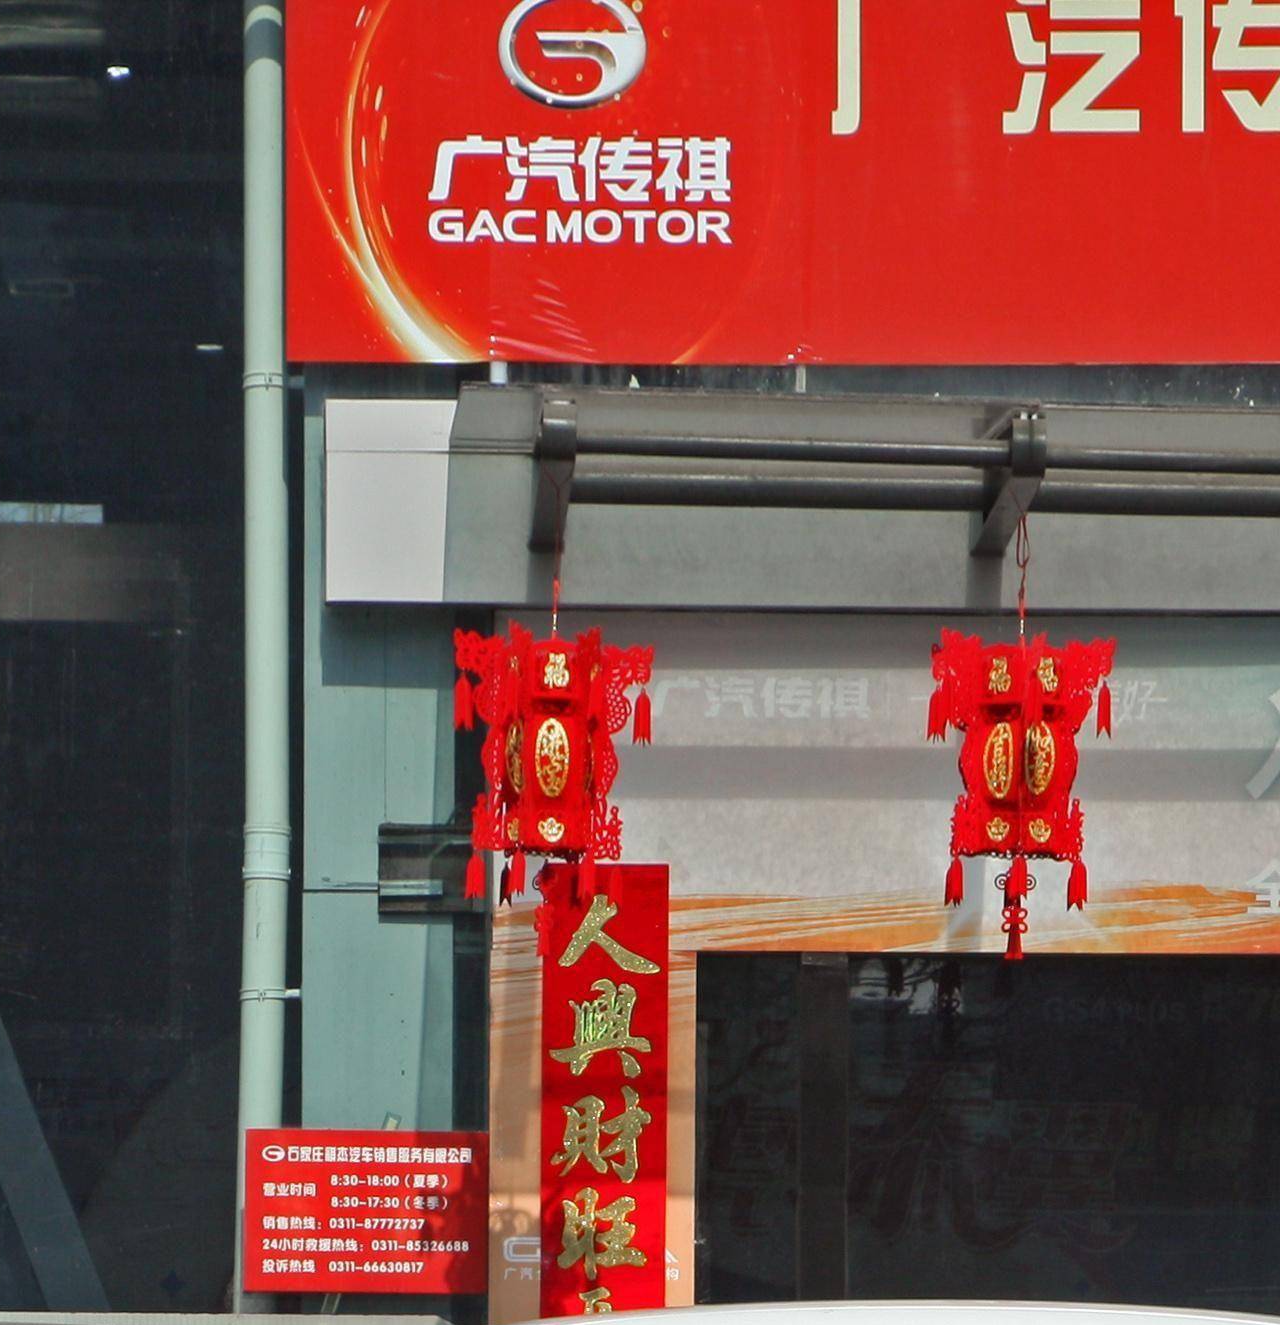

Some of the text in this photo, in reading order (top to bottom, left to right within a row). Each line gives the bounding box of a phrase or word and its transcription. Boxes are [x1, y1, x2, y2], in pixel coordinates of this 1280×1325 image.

[428, 136, 732, 203] 广汽传祺
[428, 209, 733, 244] GAC MOTOR
[262, 1182, 317, 1197] 营业时间
[261, 1259, 425, 1274] 投诉热线 0311-66630817
